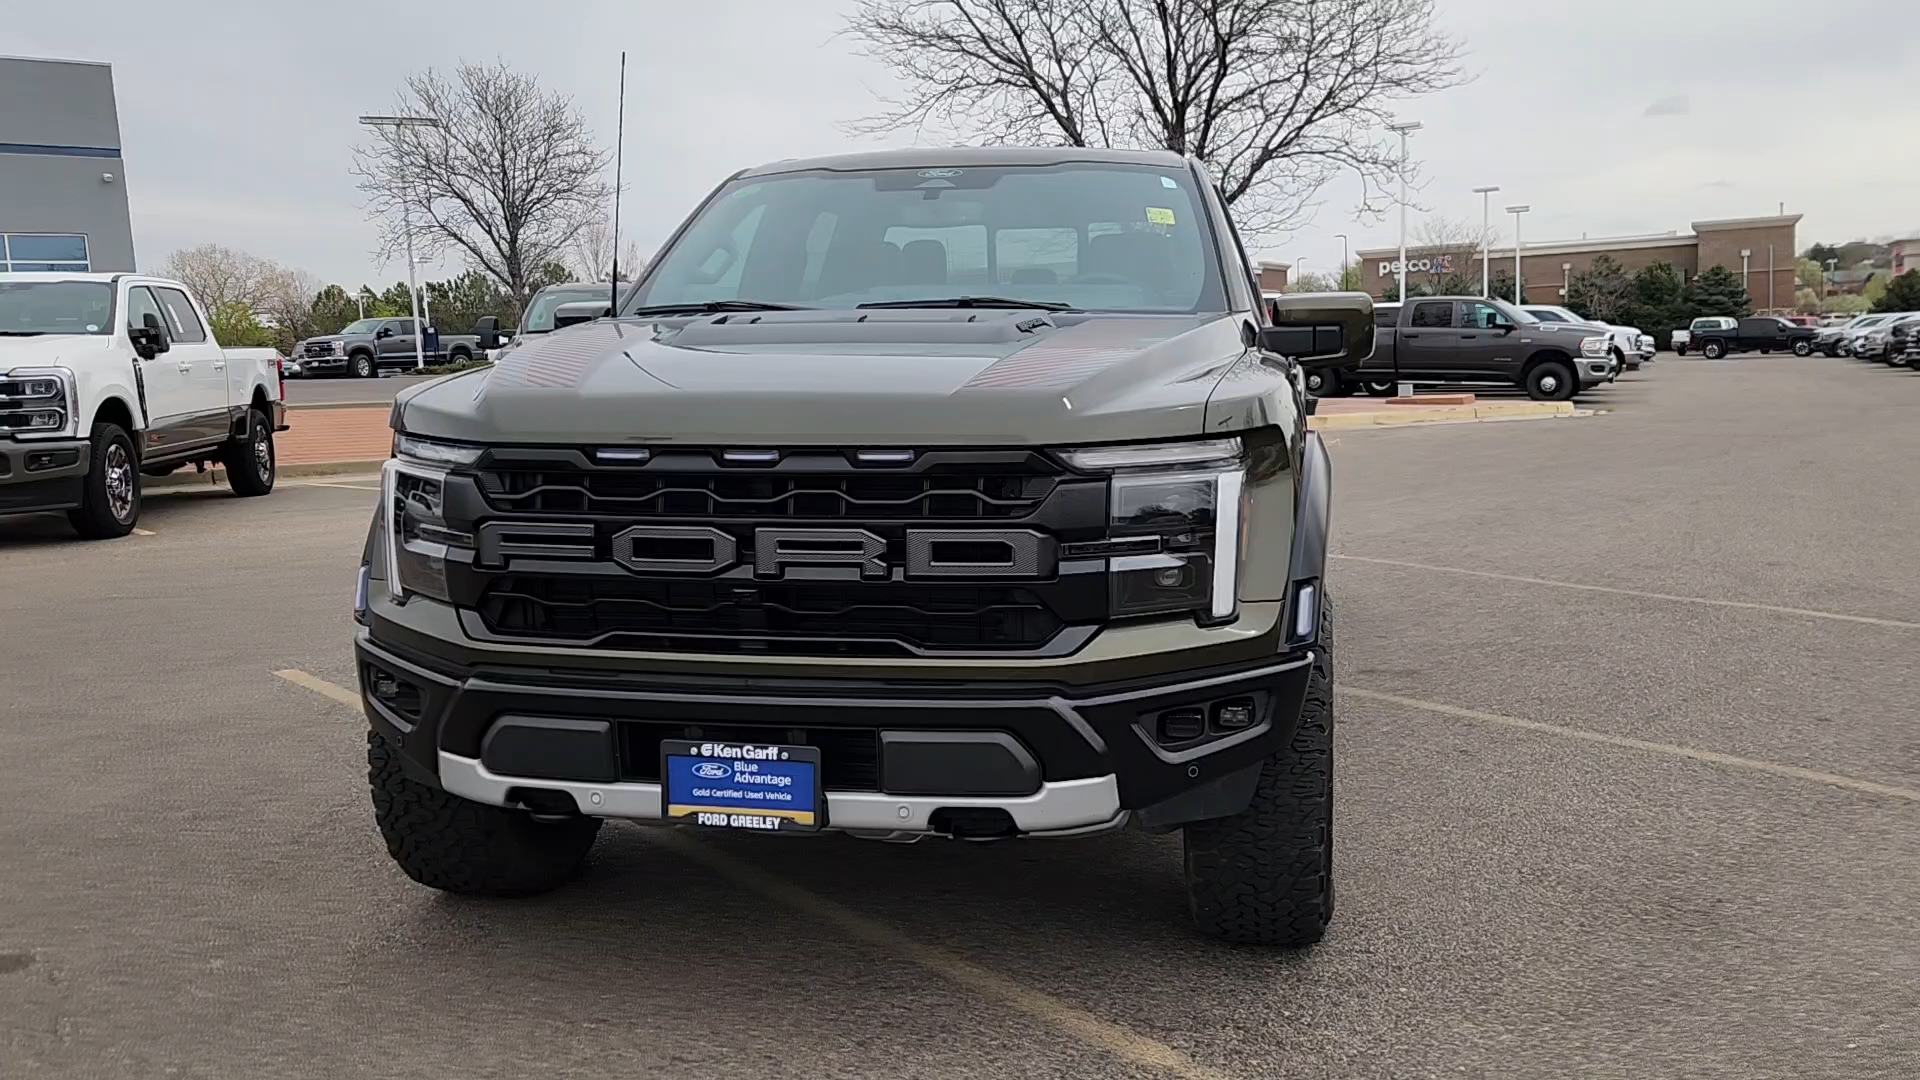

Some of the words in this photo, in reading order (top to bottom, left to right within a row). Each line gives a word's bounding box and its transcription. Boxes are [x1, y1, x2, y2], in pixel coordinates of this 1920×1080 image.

[479, 520, 1043, 577] FORD
[713, 743, 742, 758] Ken
[742, 745, 779, 760] Garff
[699, 764, 724, 776] Ford
[733, 761, 758, 772] Blue
[733, 772, 792, 787] Advantage
[692, 788, 710, 797] Gold
[711, 788, 743, 799] Certified
[744, 790, 764, 800] Used
[765, 791, 792, 801] Vehicle
[697, 812, 728, 827] FORD
[729, 814, 781, 830] GREELEY
